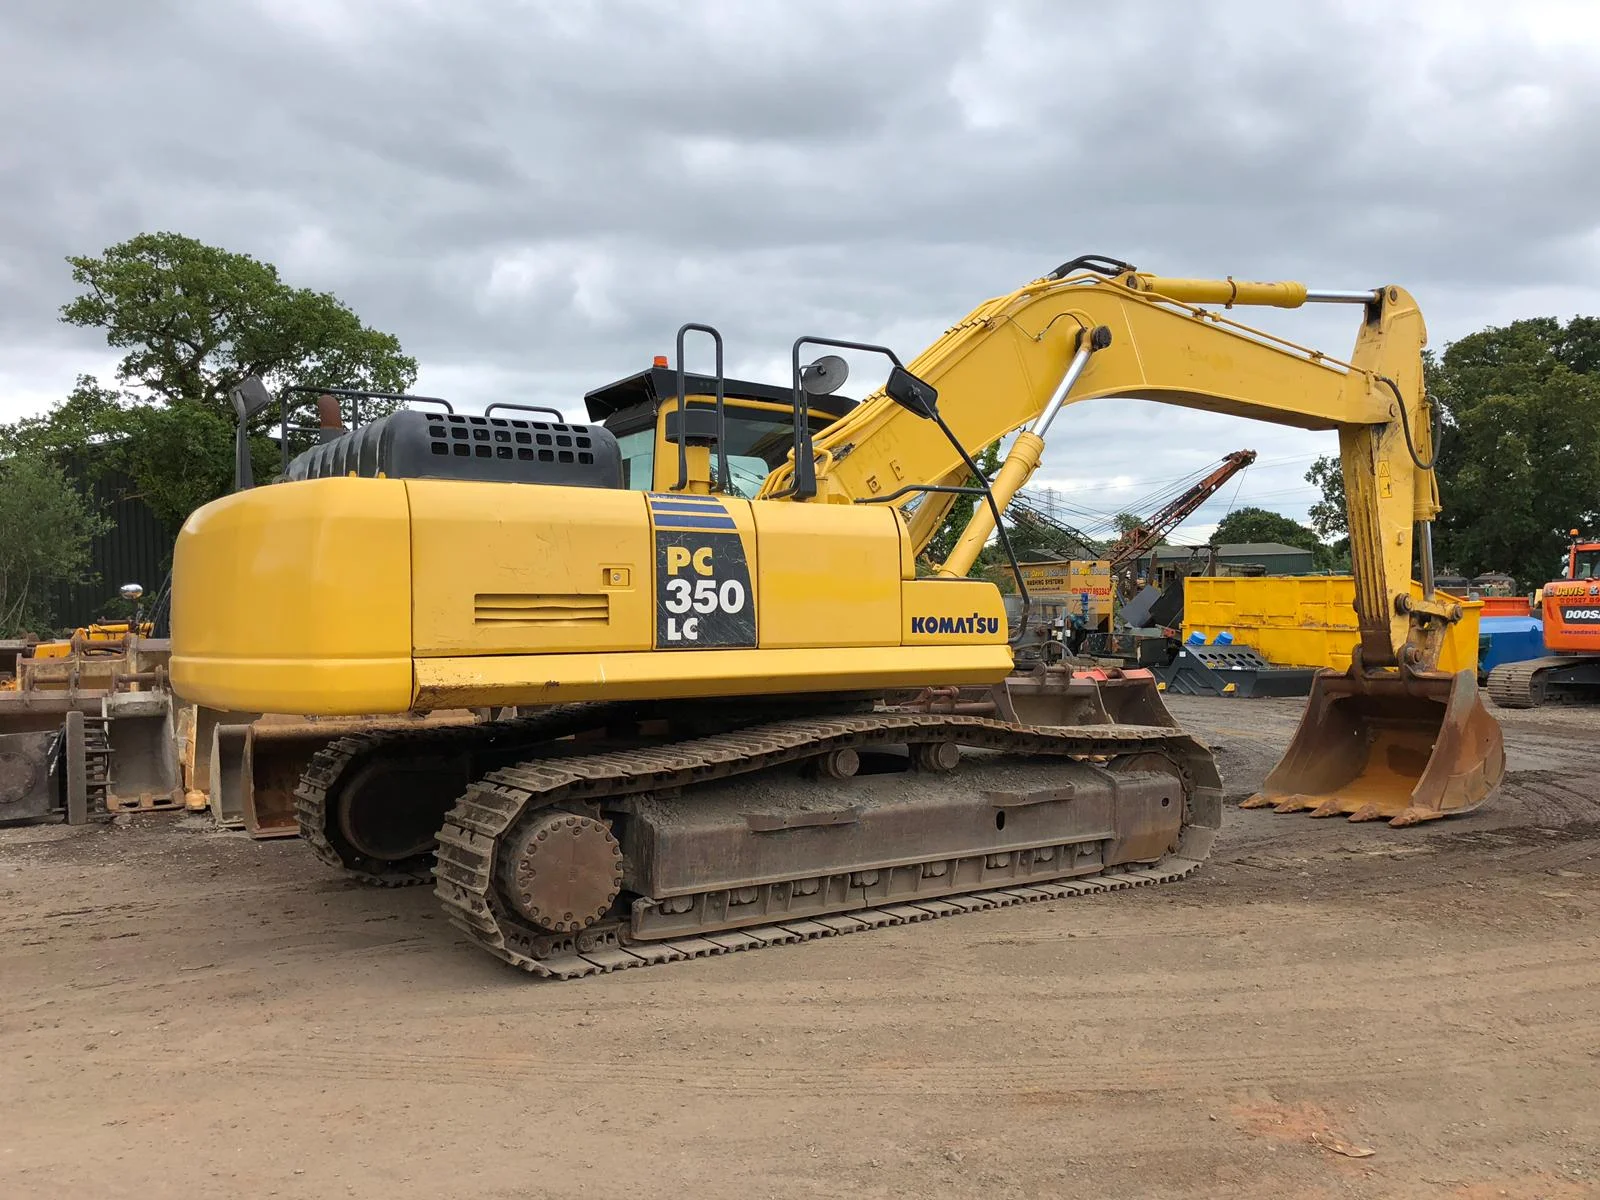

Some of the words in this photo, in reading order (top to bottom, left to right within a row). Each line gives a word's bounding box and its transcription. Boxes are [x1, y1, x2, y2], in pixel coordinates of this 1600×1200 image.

[667, 546, 713, 576] PC
[665, 578, 745, 614] 350
[911, 612, 999, 633] KOMATSU
[1565, 610, 1600, 619] DOOS
[667, 617, 698, 641] LC
